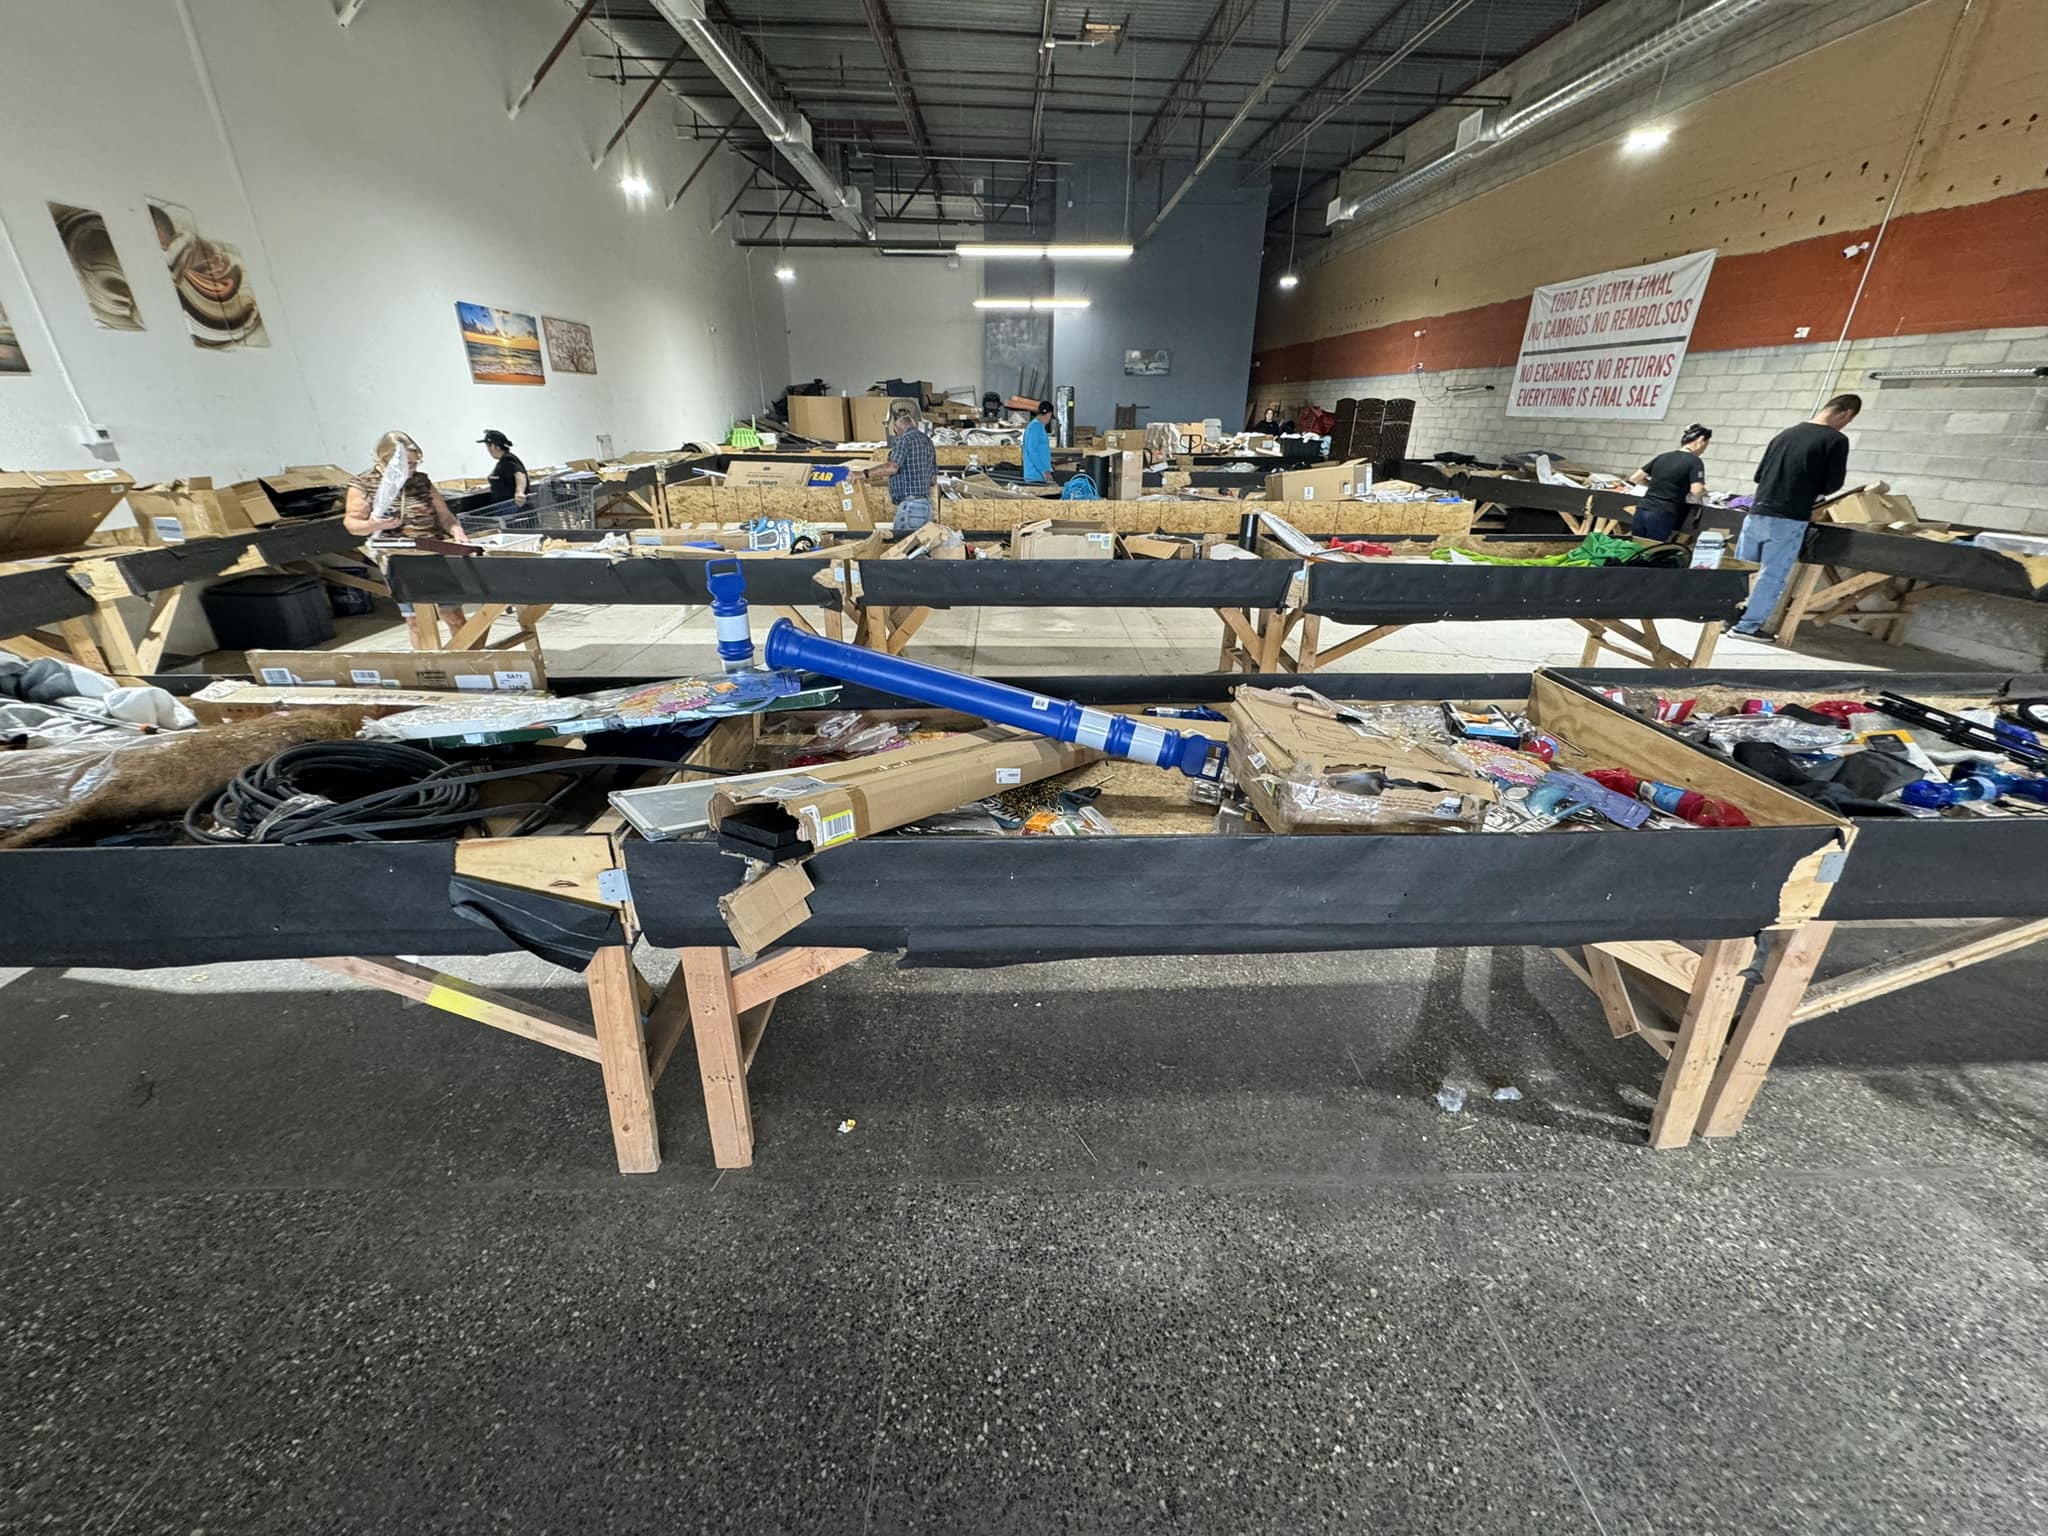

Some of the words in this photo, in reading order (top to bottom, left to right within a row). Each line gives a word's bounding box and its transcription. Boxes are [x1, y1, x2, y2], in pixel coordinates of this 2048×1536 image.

[1550, 289, 1579, 314] TODO
[1579, 286, 1596, 309] ES
[1596, 279, 1635, 306] VENTA
[1635, 271, 1675, 299] FINAL
[1527, 321, 1543, 342] NO
[1544, 313, 1591, 340] CAMBIOS
[1591, 310, 1610, 334] NO
[1610, 297, 1693, 332] REMBOLSOS
[1519, 364, 1534, 383] NO
[1533, 359, 1594, 383] EXCHANGES
[1594, 358, 1613, 380] NO
[1613, 352, 1676, 380] RETURNS
[1516, 386, 1576, 407] EVERYTHING
[1576, 386, 1590, 407] IS
[1589, 385, 1624, 407] FINAL
[1626, 384, 1663, 407] SALE
[811, 471, 834, 482] EAR
